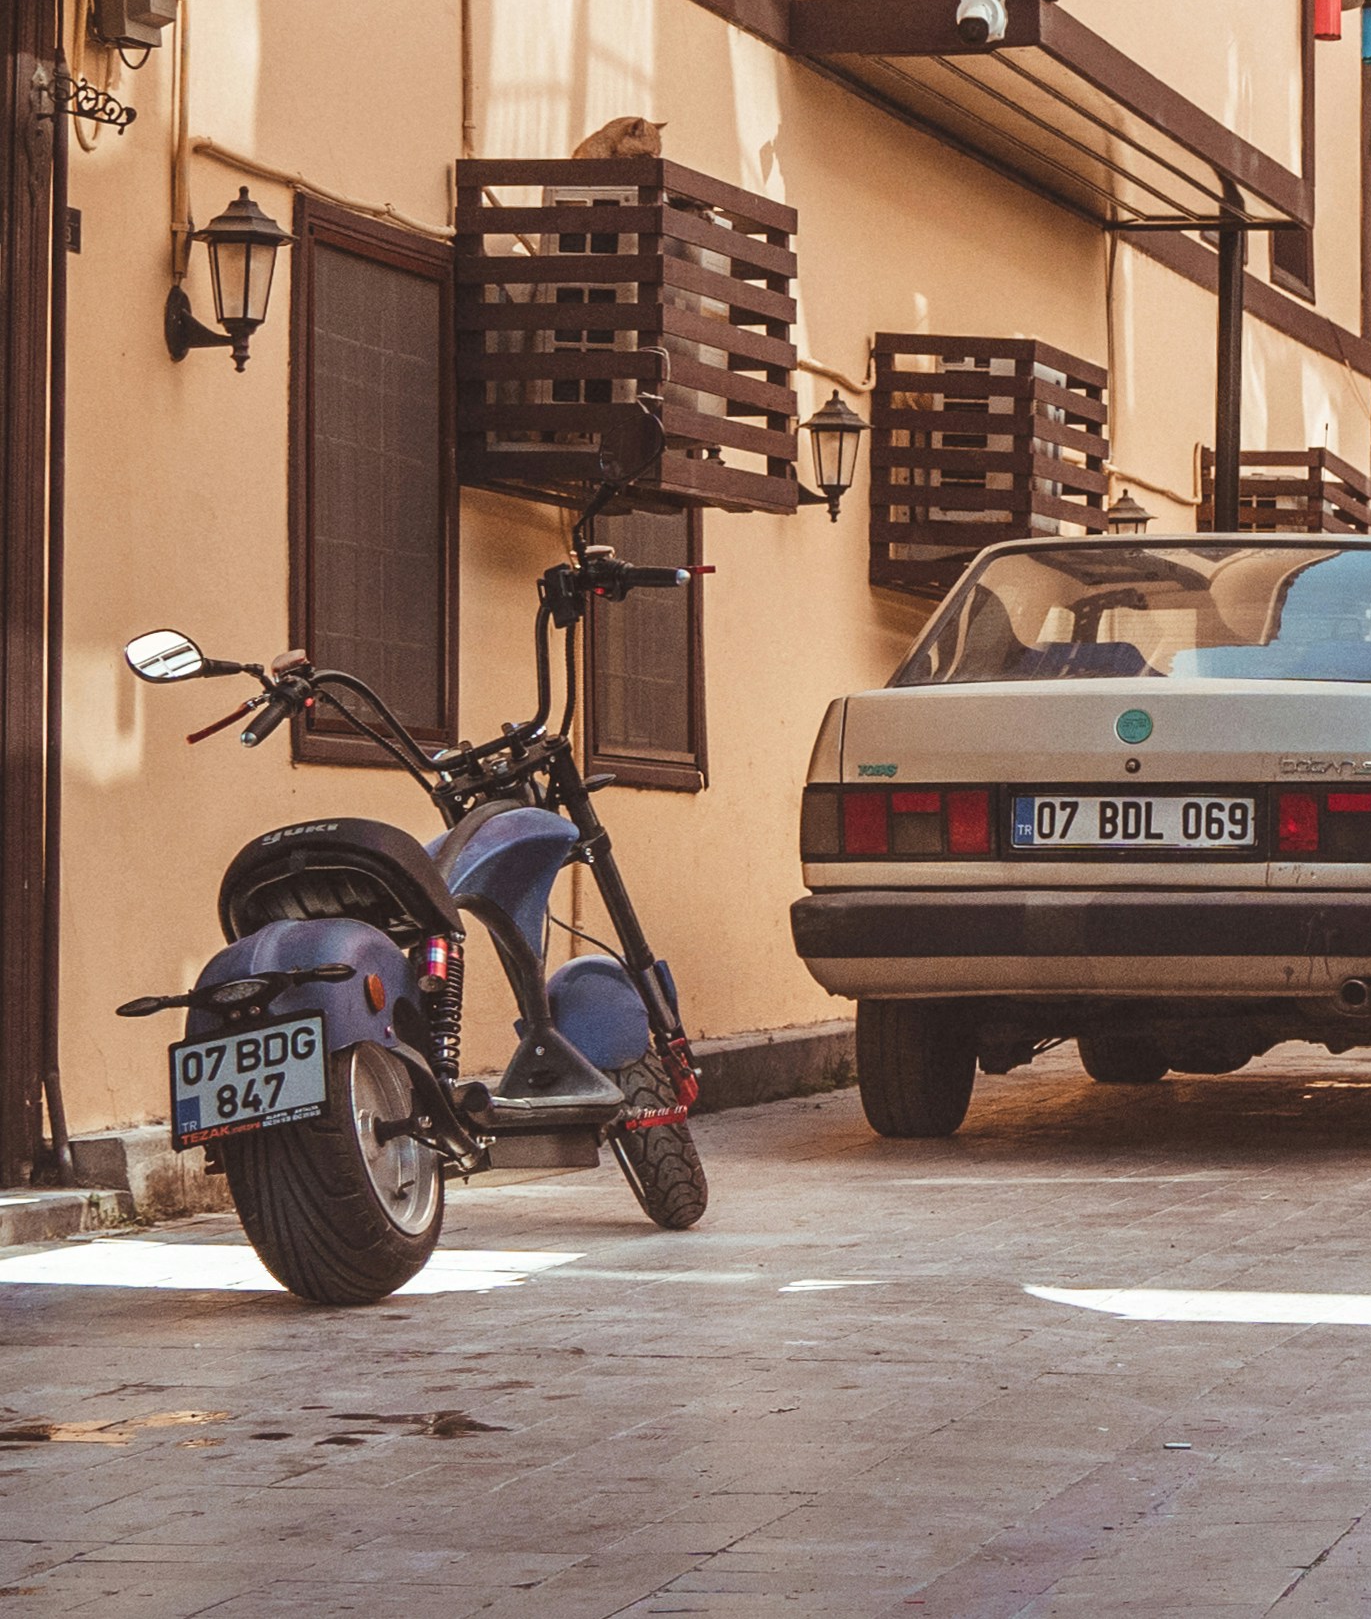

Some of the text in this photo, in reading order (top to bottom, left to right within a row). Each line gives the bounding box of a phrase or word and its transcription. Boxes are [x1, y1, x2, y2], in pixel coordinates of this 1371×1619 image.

[1017, 824, 1032, 836] TR
[1037, 801, 1249, 840] 07 BDL 069
[182, 1026, 316, 1086] 07 BDG
[216, 1071, 285, 1119] 847
[181, 1126, 230, 1145] TEZAK
[182, 1122, 198, 1133] TR
